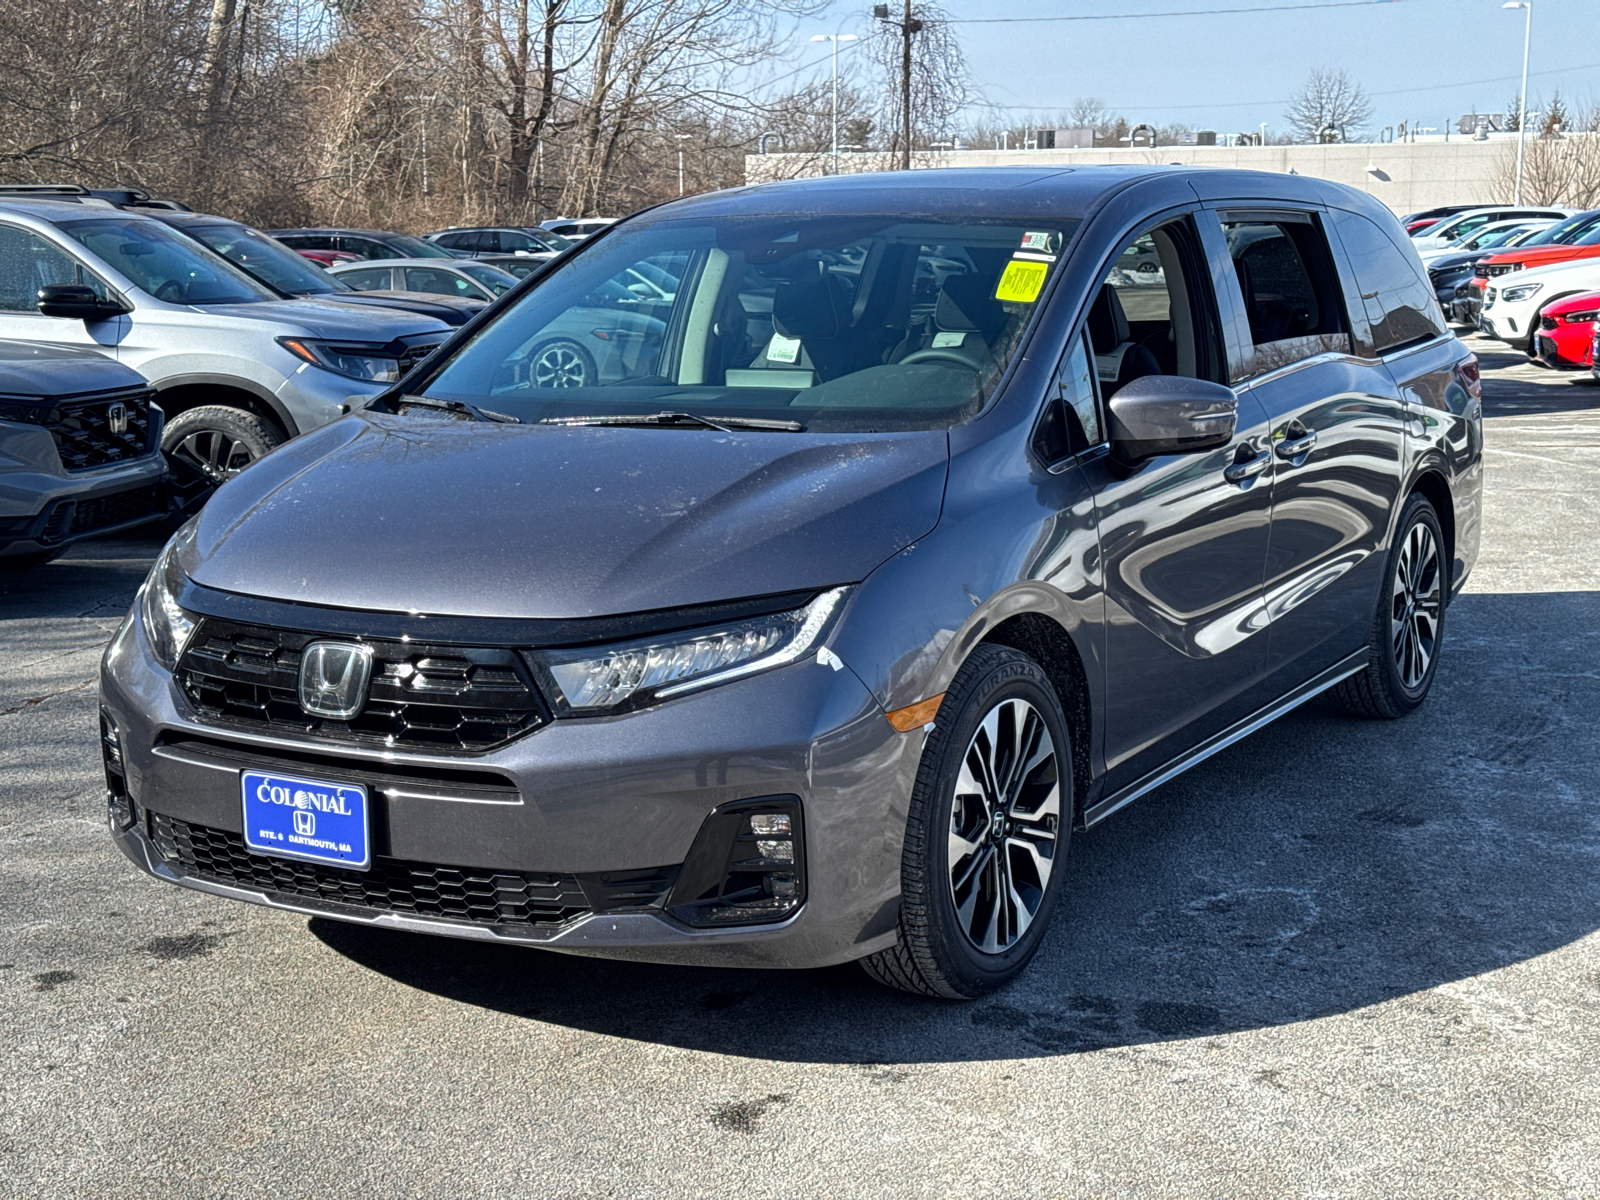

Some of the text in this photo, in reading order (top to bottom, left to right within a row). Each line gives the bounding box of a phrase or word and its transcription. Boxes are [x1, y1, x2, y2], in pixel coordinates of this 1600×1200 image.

[972, 665, 1035, 707] TURANZA
[257, 784, 352, 816] COLONIAL
[259, 830, 352, 853] RTE. 6 DARTMOUTH, MA
